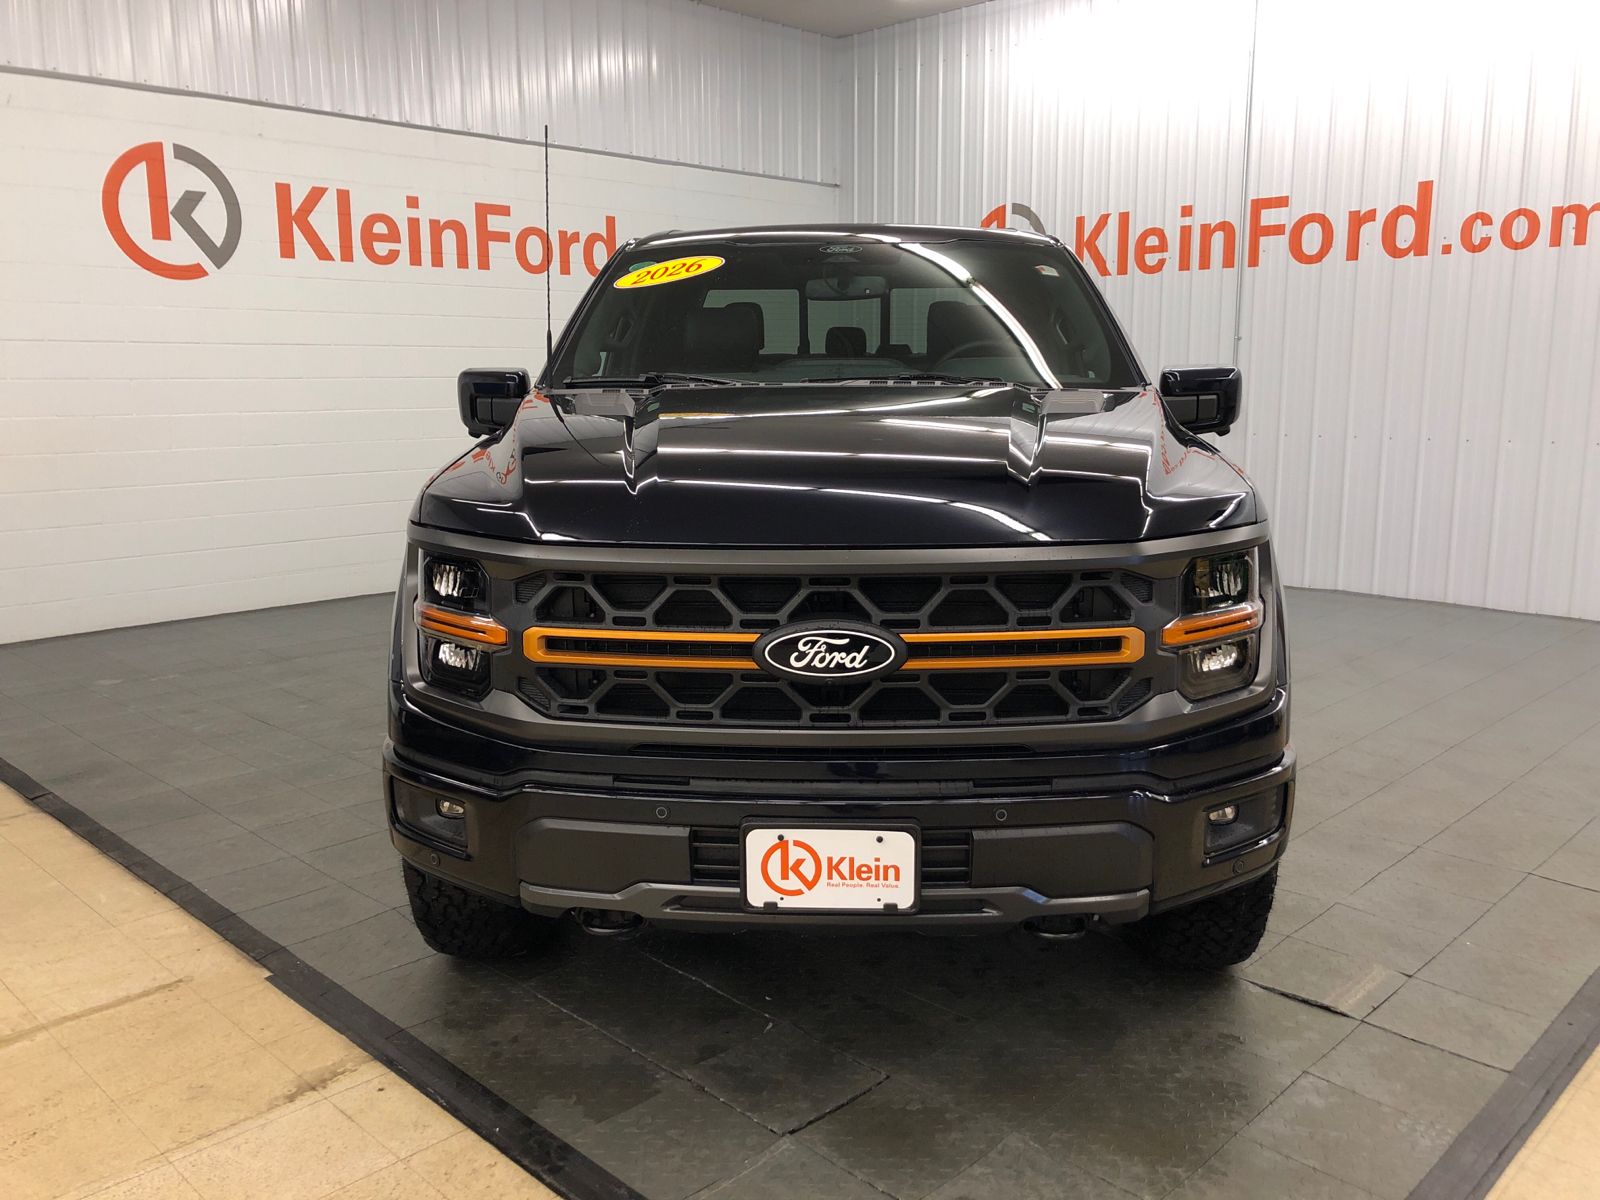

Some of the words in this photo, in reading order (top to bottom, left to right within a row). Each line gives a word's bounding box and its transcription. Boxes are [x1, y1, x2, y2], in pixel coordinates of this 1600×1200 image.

[274, 181, 617, 278] KleinFord
[1075, 180, 1600, 277] KleinFord.com
[630, 259, 707, 286] 2026
[789, 636, 870, 668] Ford
[826, 856, 900, 882] Klein
